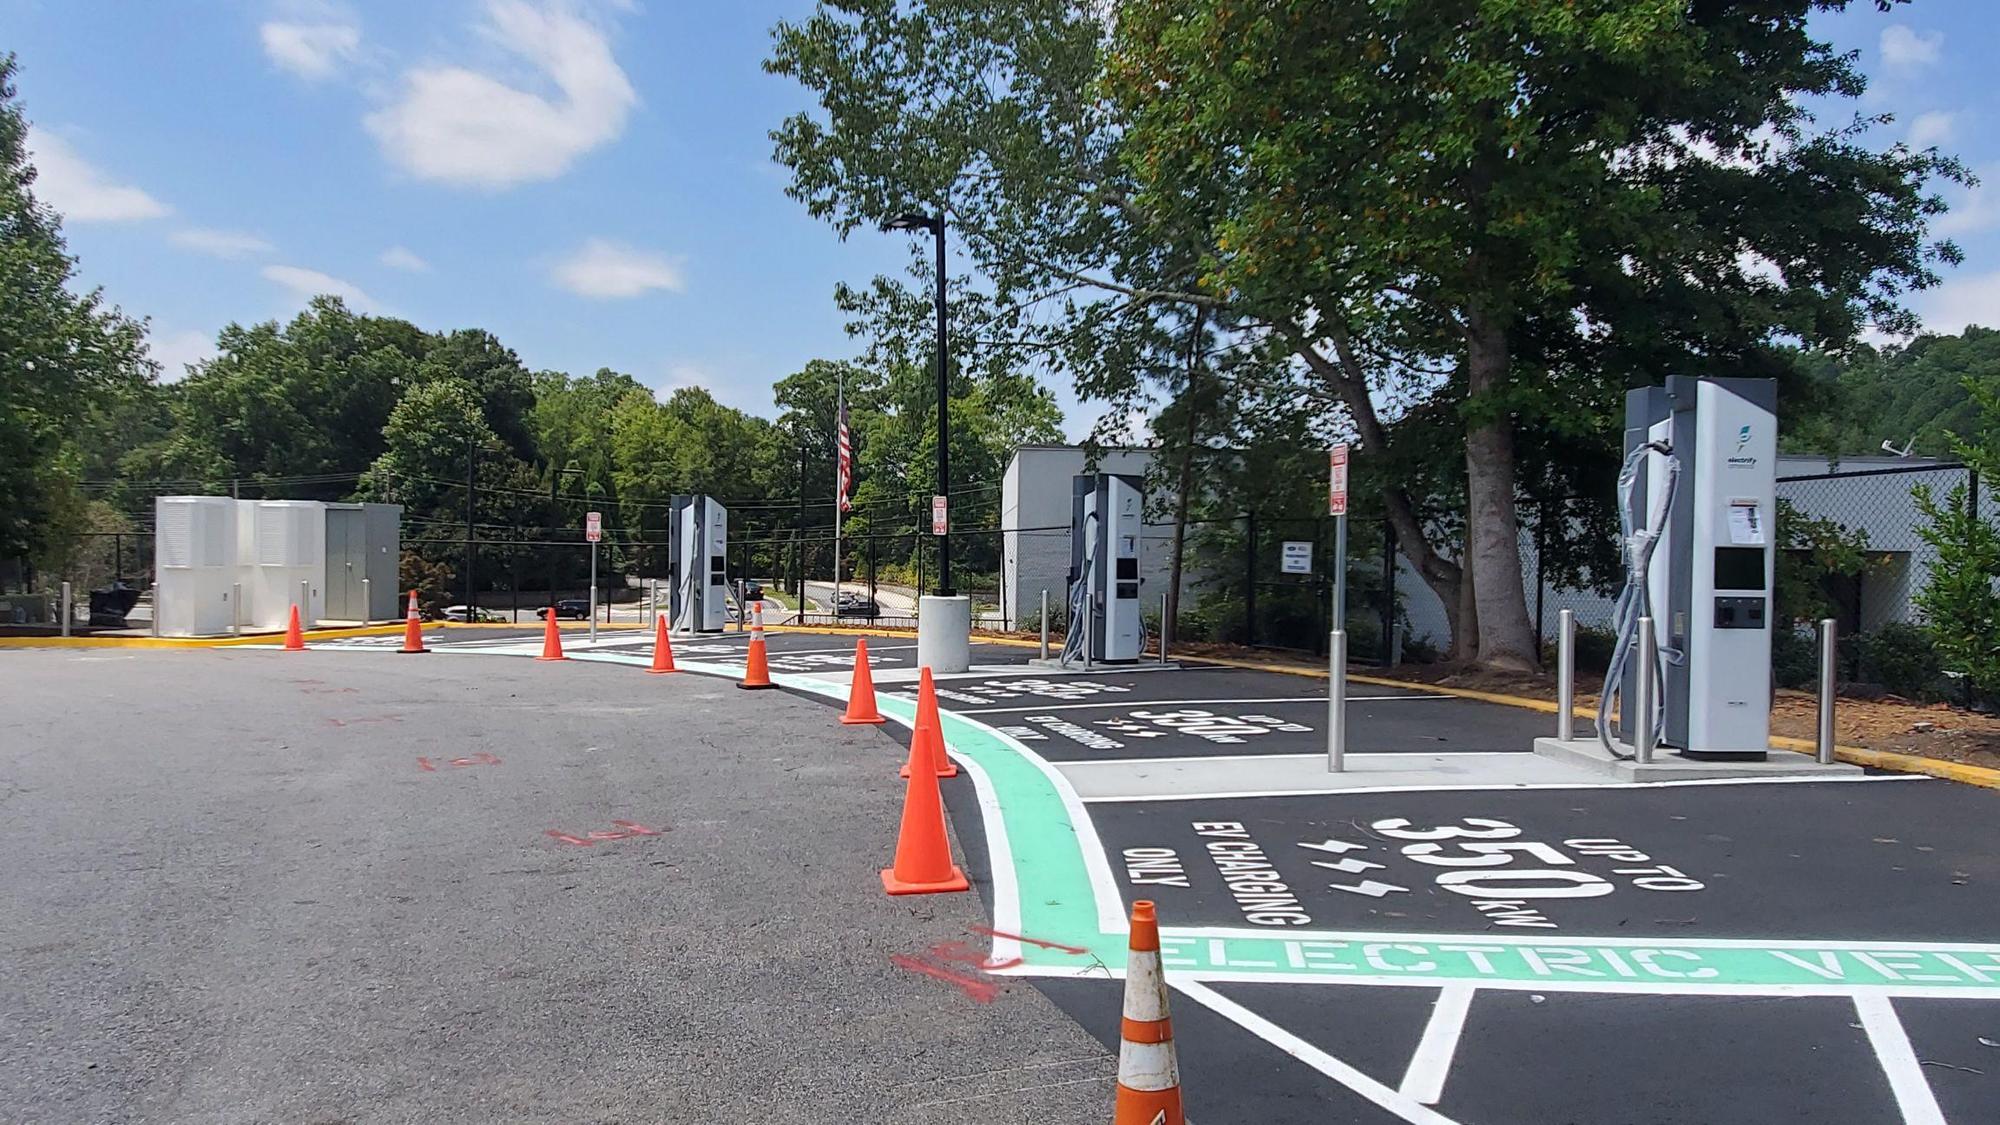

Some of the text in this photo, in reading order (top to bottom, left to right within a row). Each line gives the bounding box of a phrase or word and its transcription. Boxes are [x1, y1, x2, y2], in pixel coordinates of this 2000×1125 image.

[1129, 709, 1271, 735] 350
[1122, 847, 1191, 888] ONLY
[1191, 821, 1312, 926] EV CHARGING
[1371, 817, 1616, 898] 350
[1563, 838, 1706, 891] UP TO
